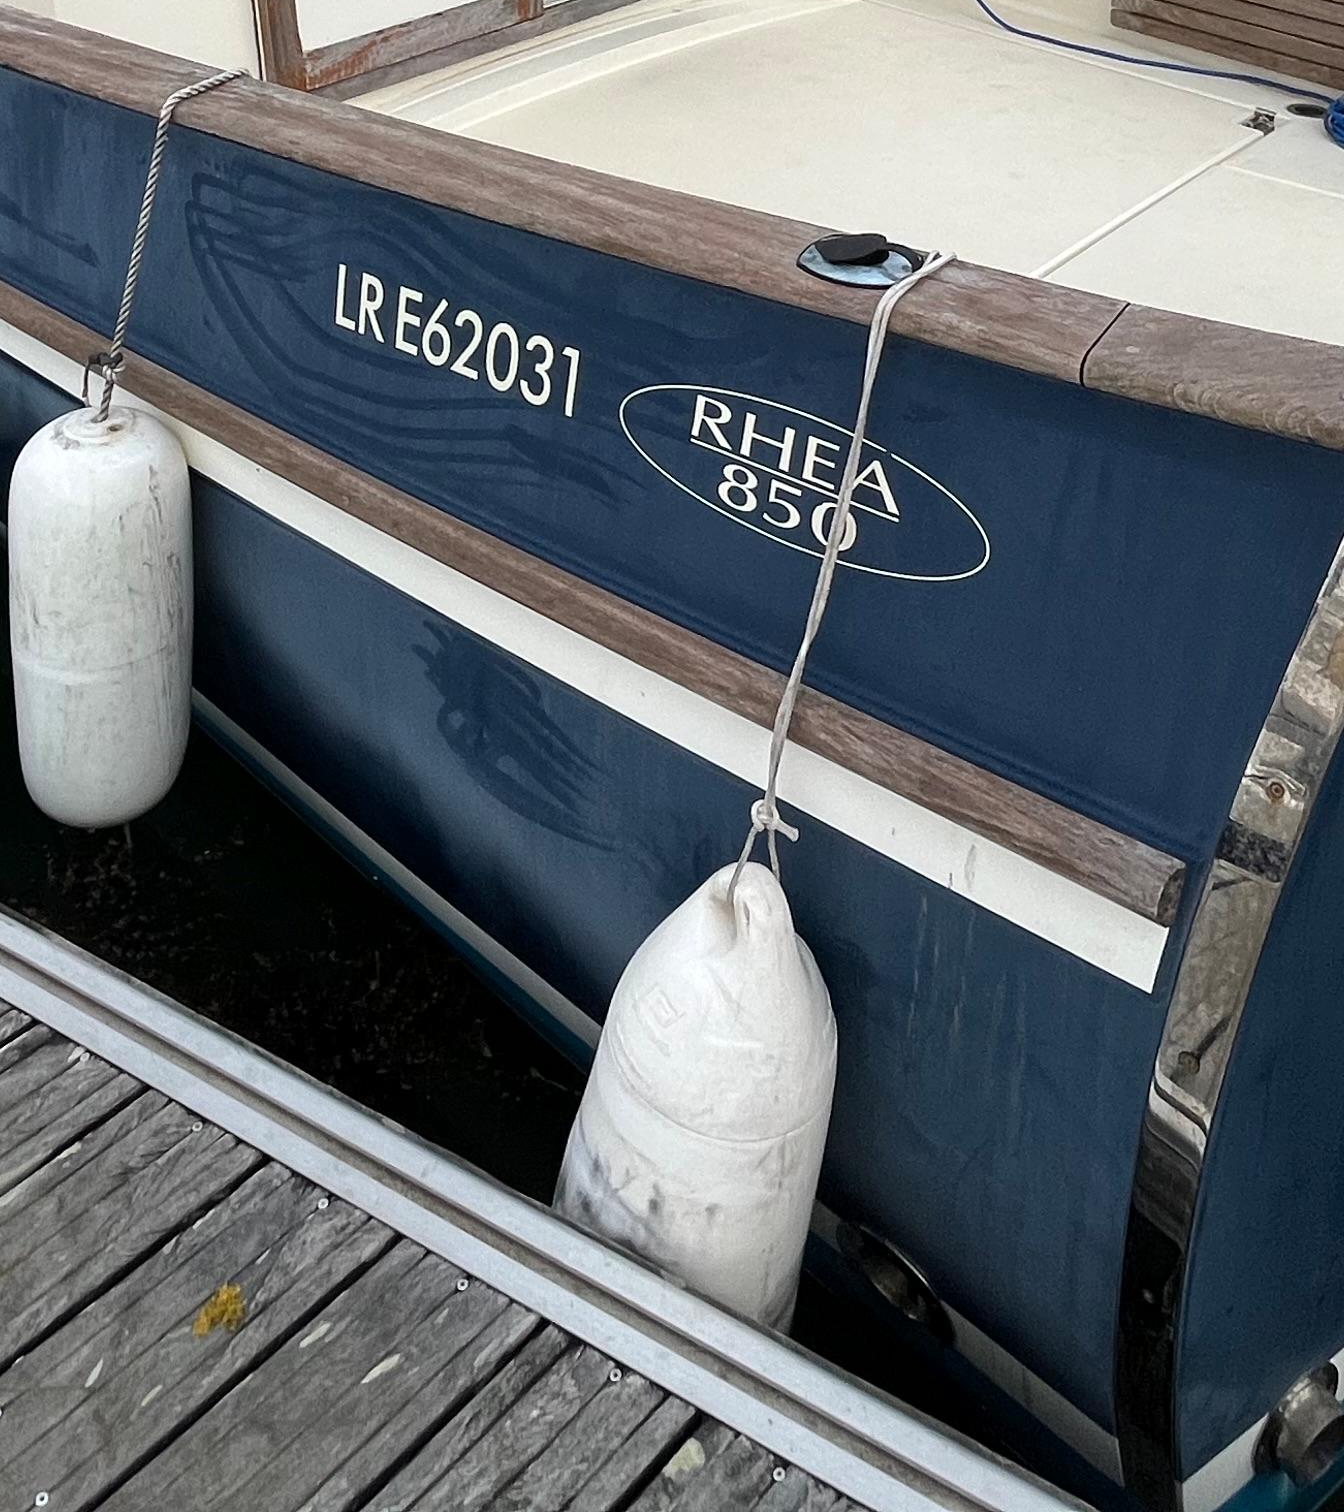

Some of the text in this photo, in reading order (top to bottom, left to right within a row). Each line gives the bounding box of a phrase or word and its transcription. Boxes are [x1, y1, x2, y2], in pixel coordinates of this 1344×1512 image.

[333, 262, 583, 418] LRE62031
[689, 394, 900, 516] RHEA
[716, 462, 858, 553] 850
